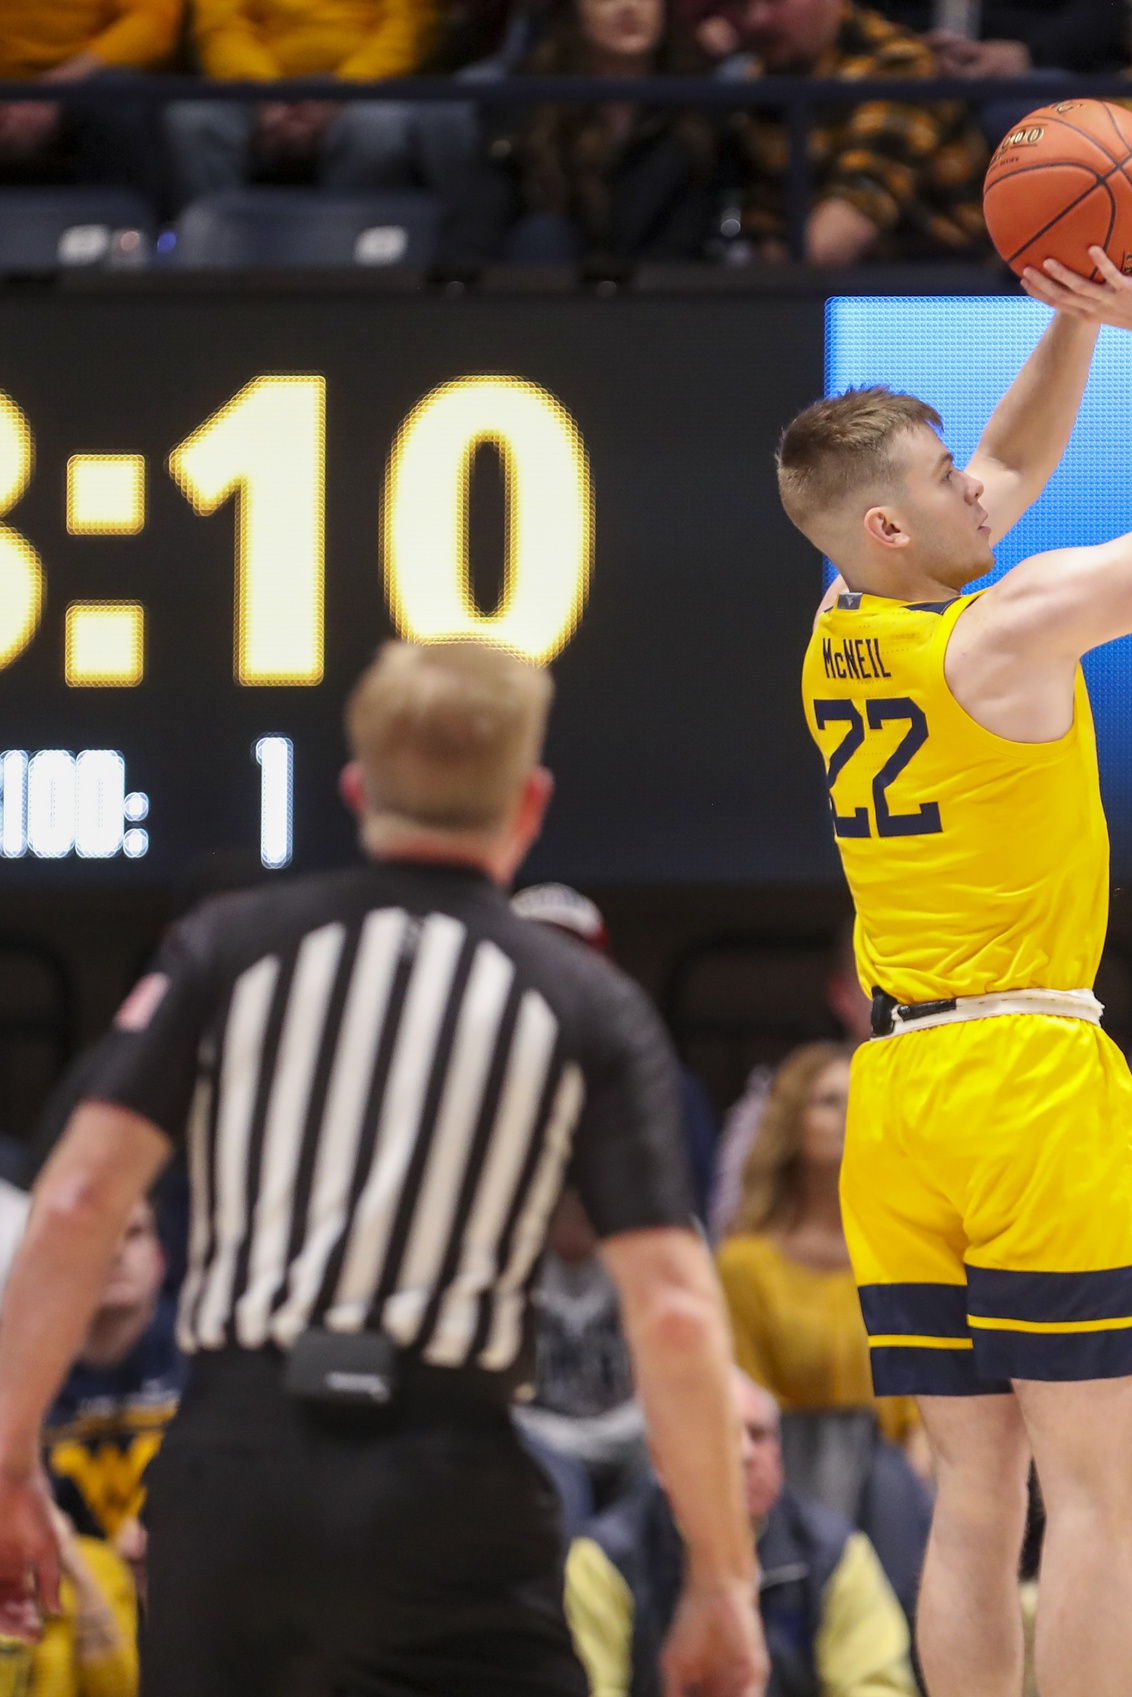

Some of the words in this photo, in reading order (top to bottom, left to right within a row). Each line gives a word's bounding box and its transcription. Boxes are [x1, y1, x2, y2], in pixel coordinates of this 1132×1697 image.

[0, 371, 596, 687] :10
[822, 637, 891, 679] McNEIL
[254, 734, 293, 868] 1
[813, 696, 943, 838] 22
